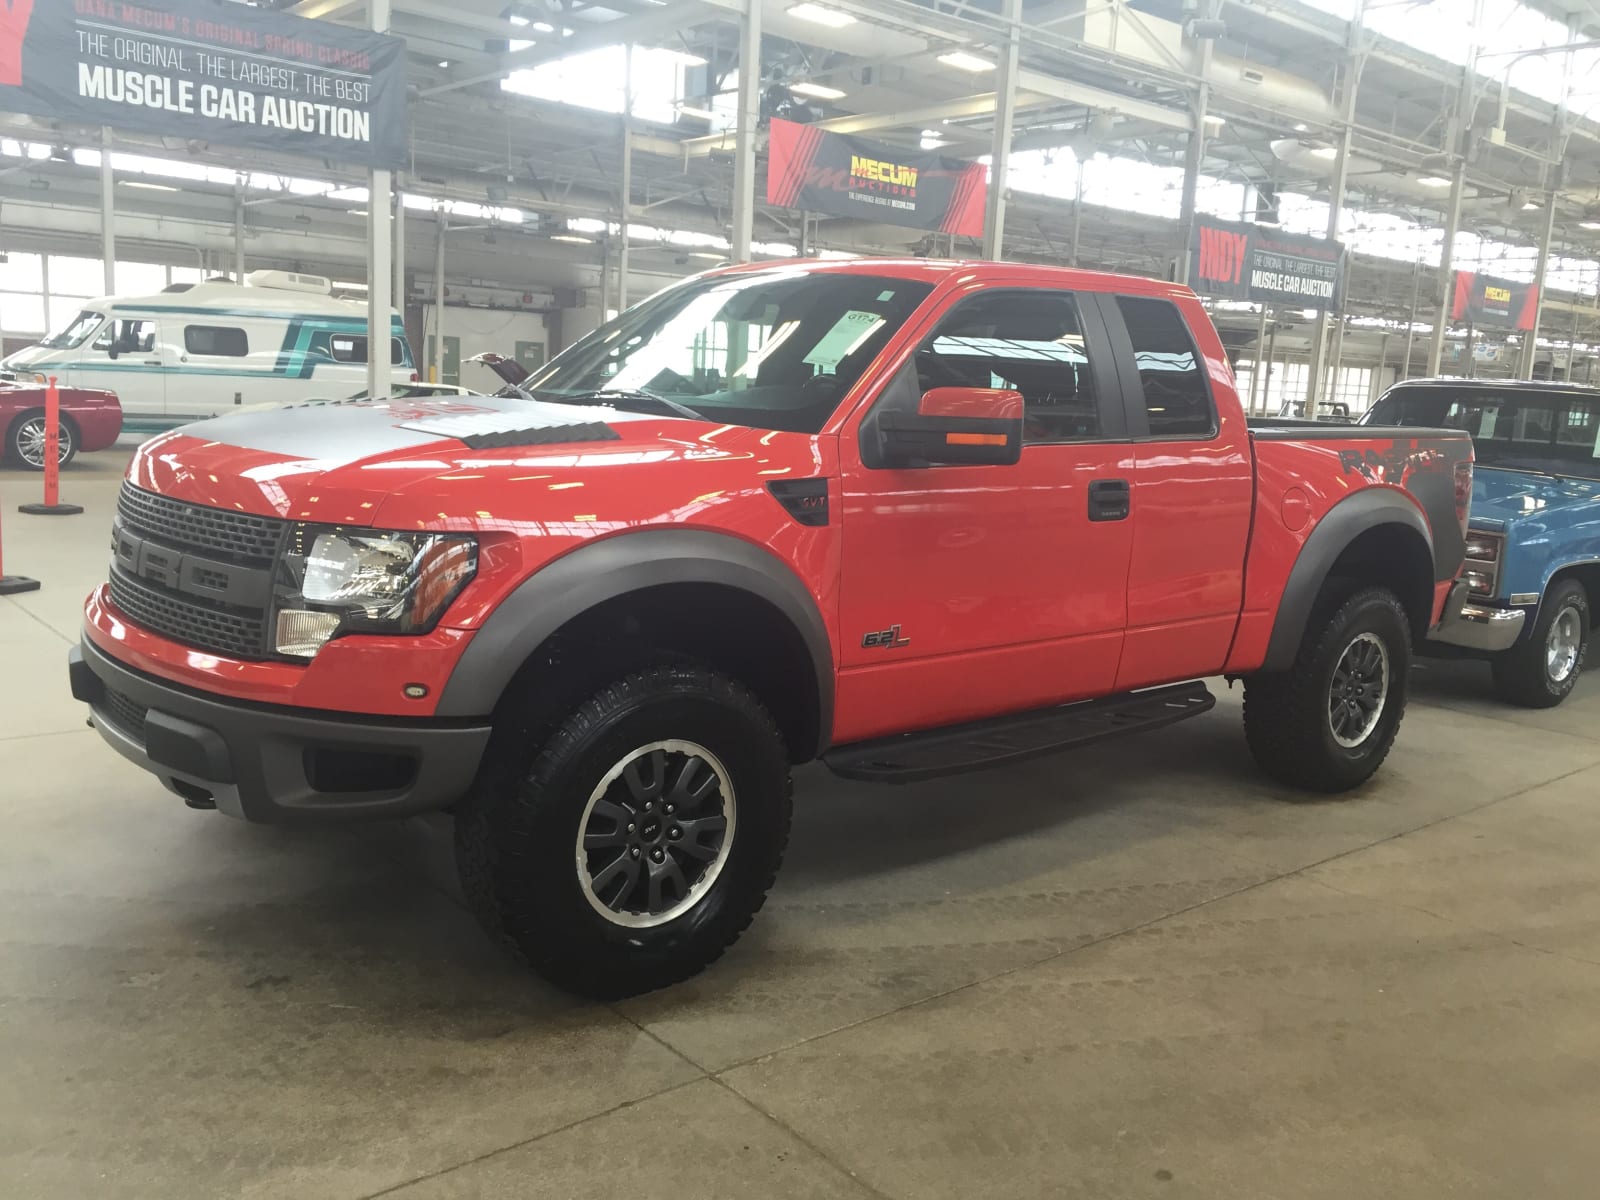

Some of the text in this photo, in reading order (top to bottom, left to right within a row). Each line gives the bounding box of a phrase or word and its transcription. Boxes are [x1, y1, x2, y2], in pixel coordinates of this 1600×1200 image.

[195, 19, 259, 48] ORIGINAL
[75, 30, 372, 104] THE ORIGINAL. THE LARGEST. THE BEST
[78, 62, 370, 143] MUSCLE CAR AUCTION
[850, 155, 918, 188] MECUM
[1199, 226, 1247, 284] INDY
[1252, 270, 1334, 298] MUSCLE CAR AUCTION
